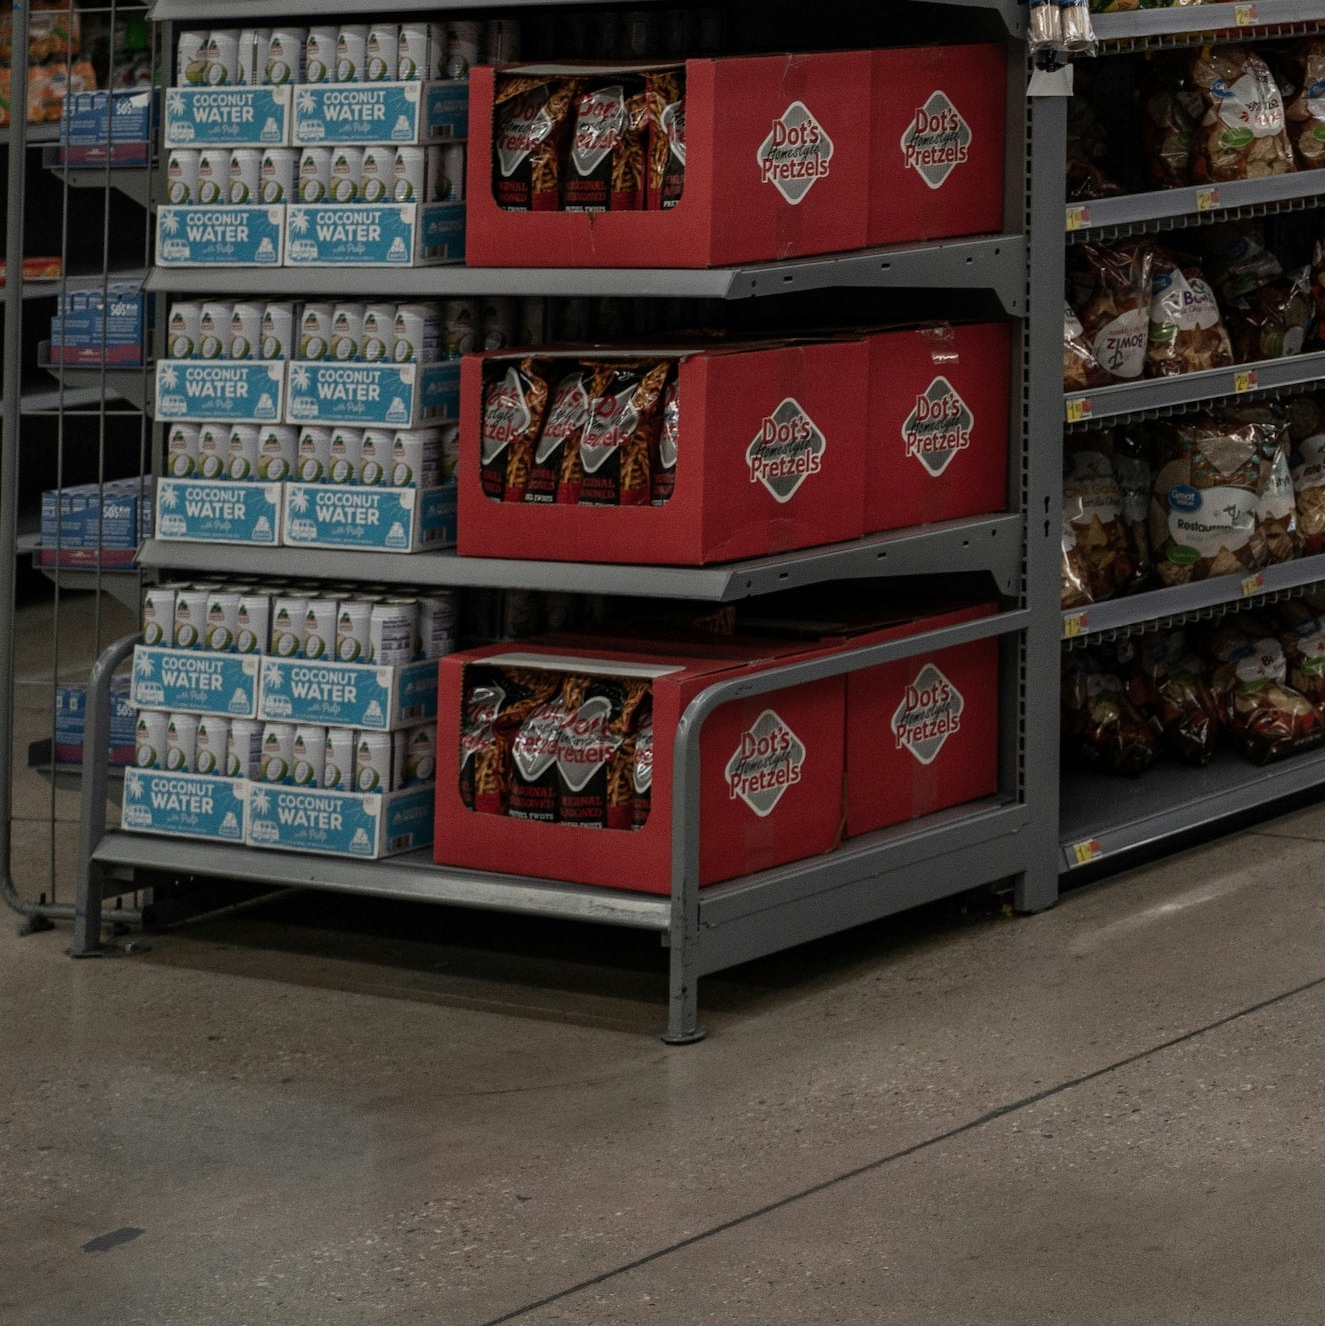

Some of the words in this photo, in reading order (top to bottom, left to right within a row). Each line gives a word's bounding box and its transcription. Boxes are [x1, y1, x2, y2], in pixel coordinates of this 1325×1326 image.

[193, 94, 254, 108] COCONUT
[323, 90, 385, 106] COCONUT
[193, 105, 254, 123] WATER
[323, 103, 386, 122] WATER
[915, 107, 958, 135] Dot's
[773, 119, 819, 147] Dot's
[768, 144, 821, 162] Homestyle
[905, 142, 968, 168] Pretzels
[762, 153, 829, 183] Pretzels
[317, 369, 380, 385] COCONUT
[317, 382, 381, 401] WATER
[917, 393, 961, 422] Dot's
[762, 416, 811, 445] Dot's
[906, 425, 969, 457] Pretzels
[751, 449, 821, 482] Pretzels
[292, 668, 357, 685] COCONUT
[292, 681, 357, 702] WATER
[905, 679, 950, 712] Dot's
[896, 712, 960, 749] Pretzels
[741, 726, 790, 760] Dot's
[278, 795, 344, 812] COCONUT
[278, 808, 343, 831] WATER
